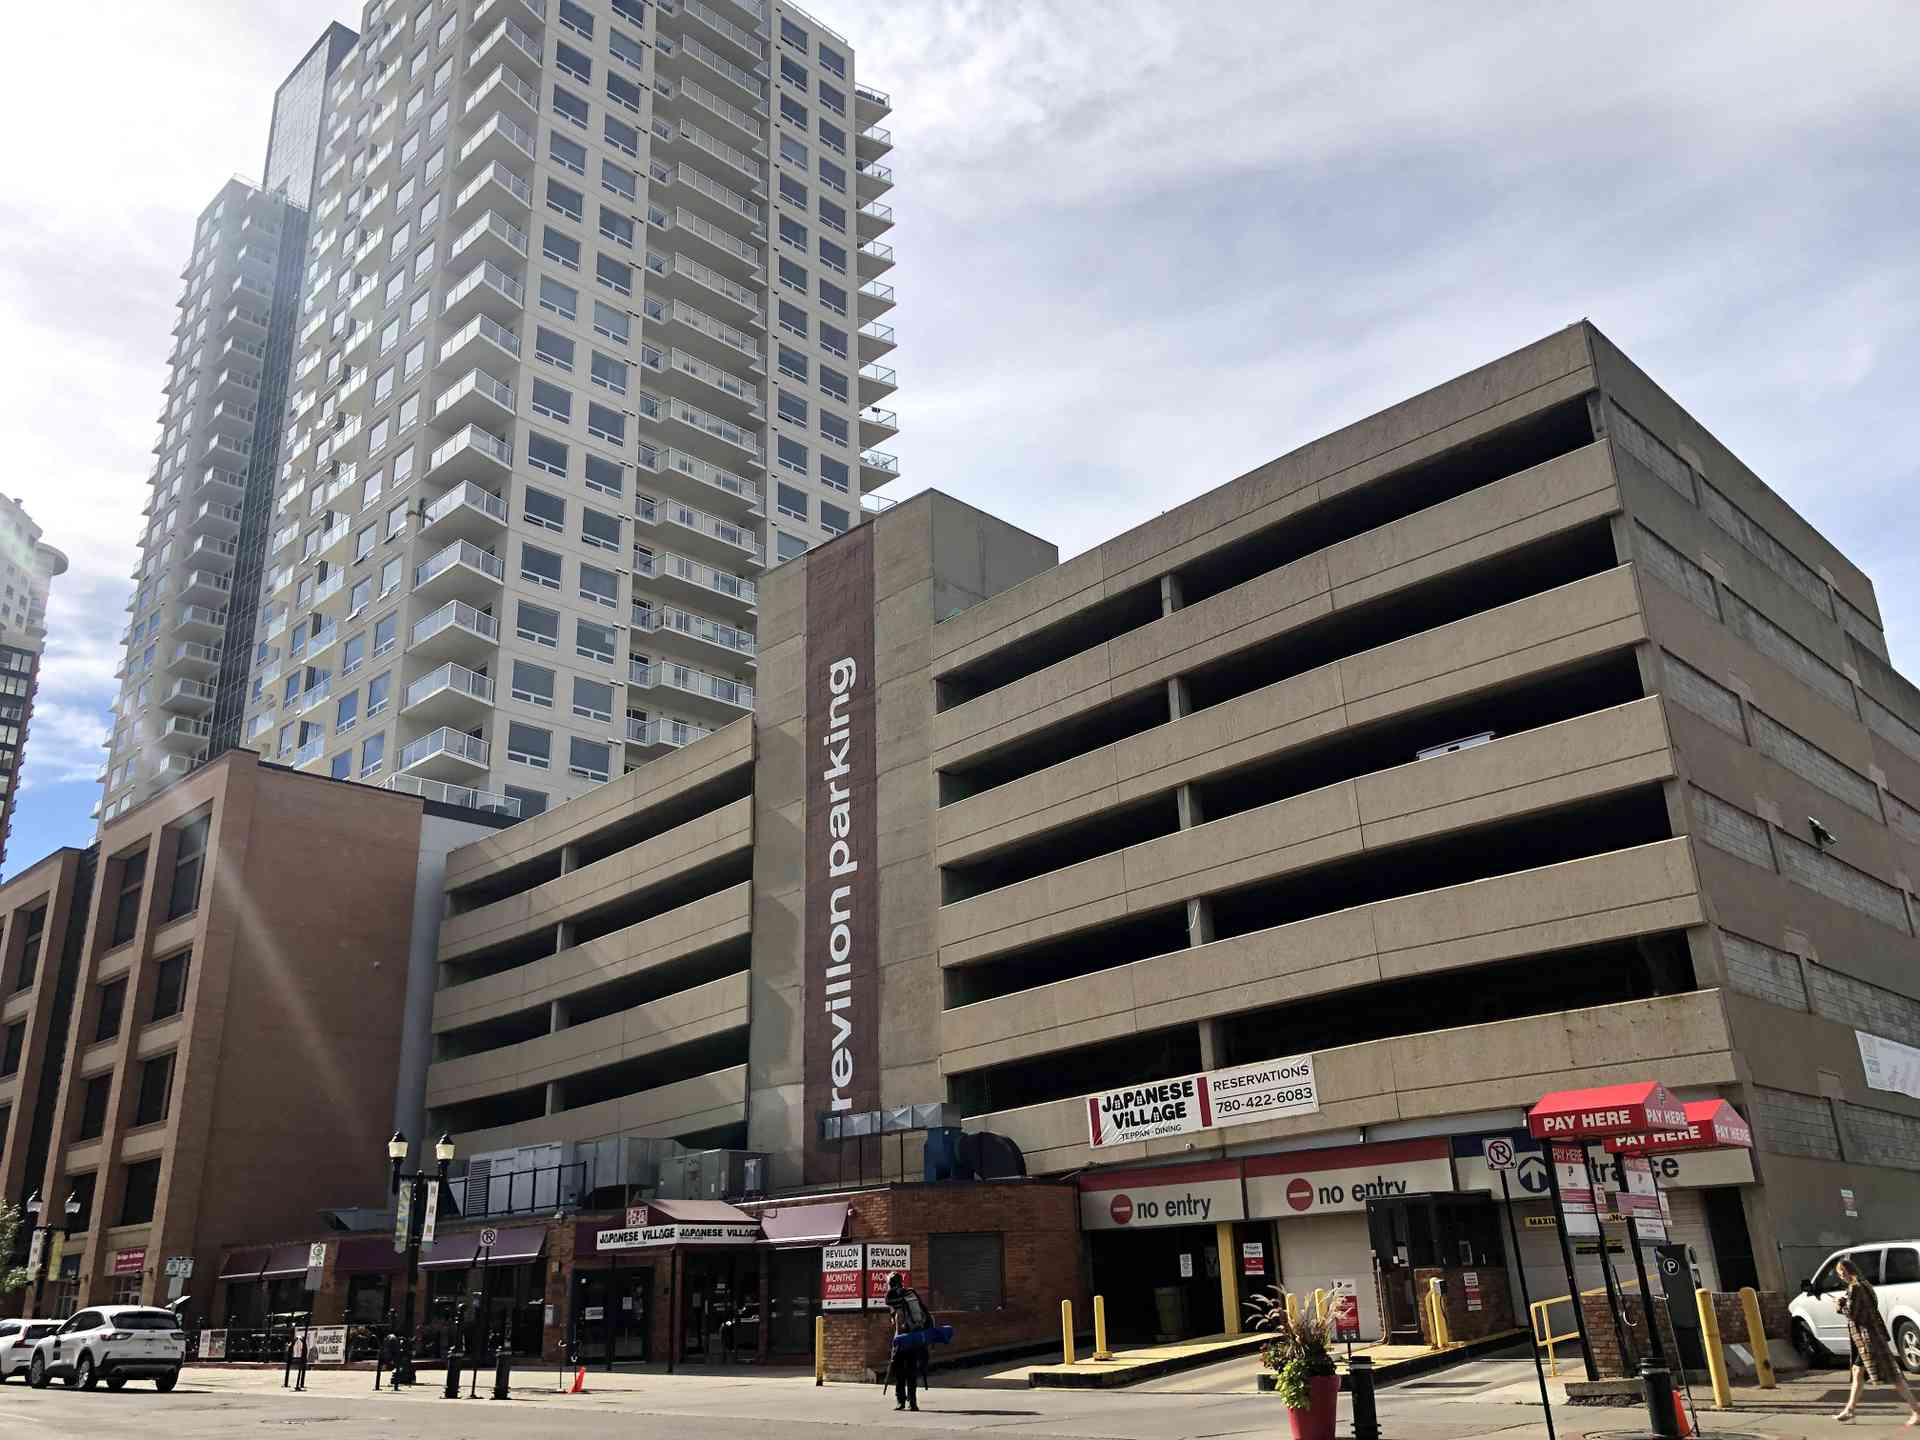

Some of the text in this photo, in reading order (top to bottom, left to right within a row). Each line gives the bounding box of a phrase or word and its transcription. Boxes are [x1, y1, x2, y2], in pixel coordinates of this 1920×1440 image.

[823, 656, 857, 1111] revillon parking
[1213, 1065, 1310, 1091] RESERVATIONS
[1102, 1080, 1194, 1112] JAPANESE
[1215, 1087, 1313, 1114] 780-422-6083
[1544, 1110, 1632, 1132] PAY HERE
[1646, 1110, 1687, 1126] PAY HERE
[1120, 1124, 1182, 1142] TEPPAN DINING
[1615, 1135, 1646, 1147] PAY
[1715, 1124, 1751, 1143] PAY HERE
[1319, 1176, 1407, 1206] no entry
[1137, 1192, 1212, 1222] no entry
[599, 1231, 639, 1244] JAPANESE
[679, 1228, 723, 1238] JAPANESE
[825, 1247, 859, 1258] REVILLON
[870, 1247, 907, 1257] REVILLON
[826, 1259, 858, 1269] PARKADE
[871, 1259, 907, 1268] PARKADE
[826, 1272, 858, 1283] MONTHLY
